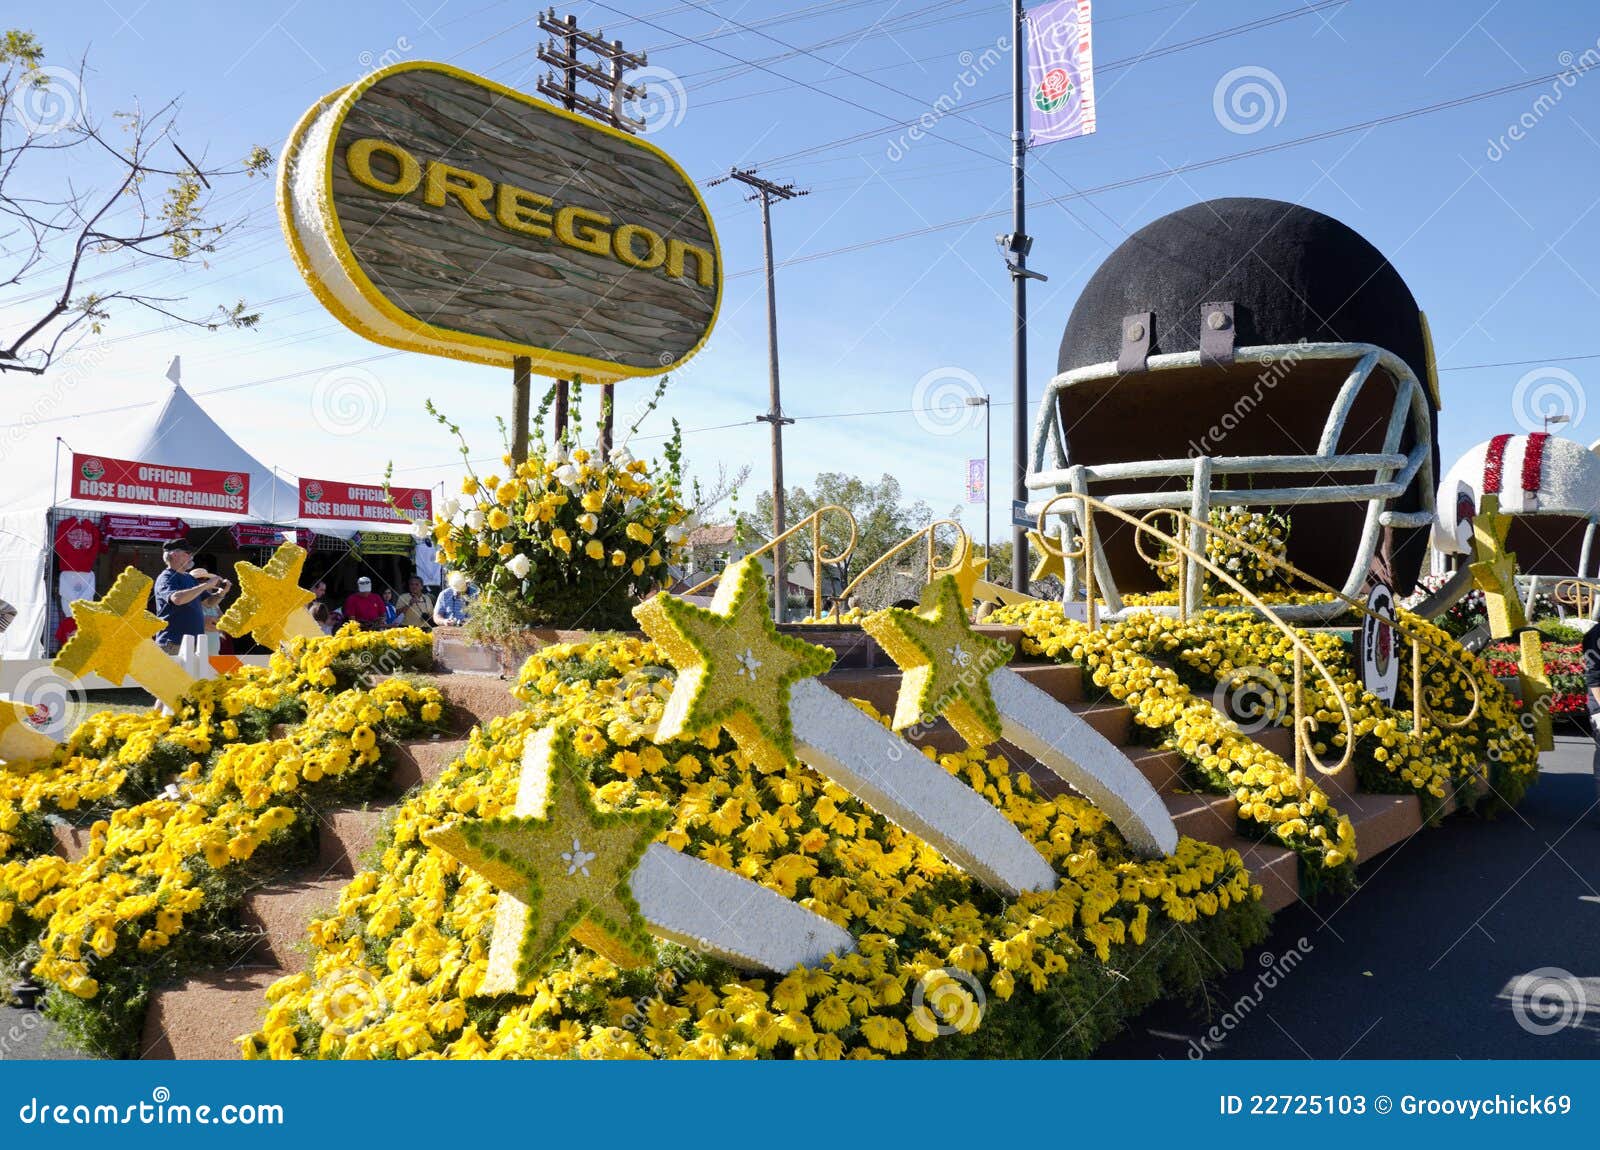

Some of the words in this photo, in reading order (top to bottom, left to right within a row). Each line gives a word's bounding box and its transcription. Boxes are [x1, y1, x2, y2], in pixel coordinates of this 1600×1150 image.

[1079, 48, 1096, 134] VIEWING
[346, 138, 714, 287] OREGON
[138, 466, 193, 486] OFFICIAL
[79, 480, 115, 497] ROSE
[117, 484, 154, 501] BOWL
[157, 488, 244, 510] MERCHANDISE
[304, 501, 331, 516] ROSE
[333, 503, 361, 518] BOWL
